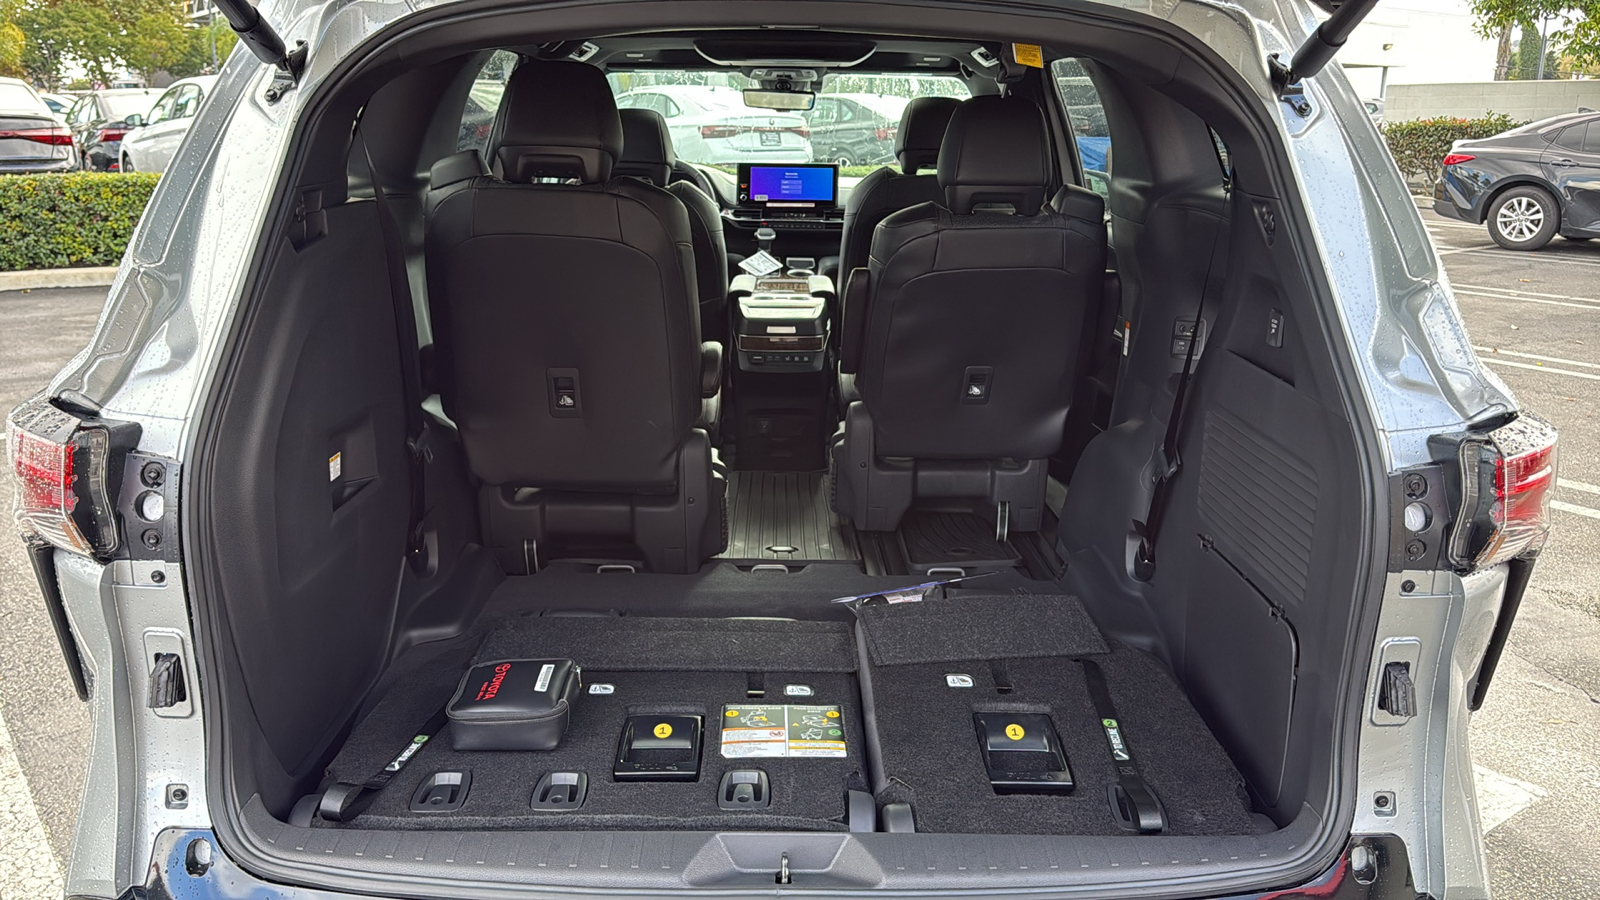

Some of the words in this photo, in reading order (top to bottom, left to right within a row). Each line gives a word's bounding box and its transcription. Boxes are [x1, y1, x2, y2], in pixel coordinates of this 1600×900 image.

[483, 671, 506, 700] TOYOTA
[659, 726, 667, 735] 1
[1011, 728, 1019, 736] 1
